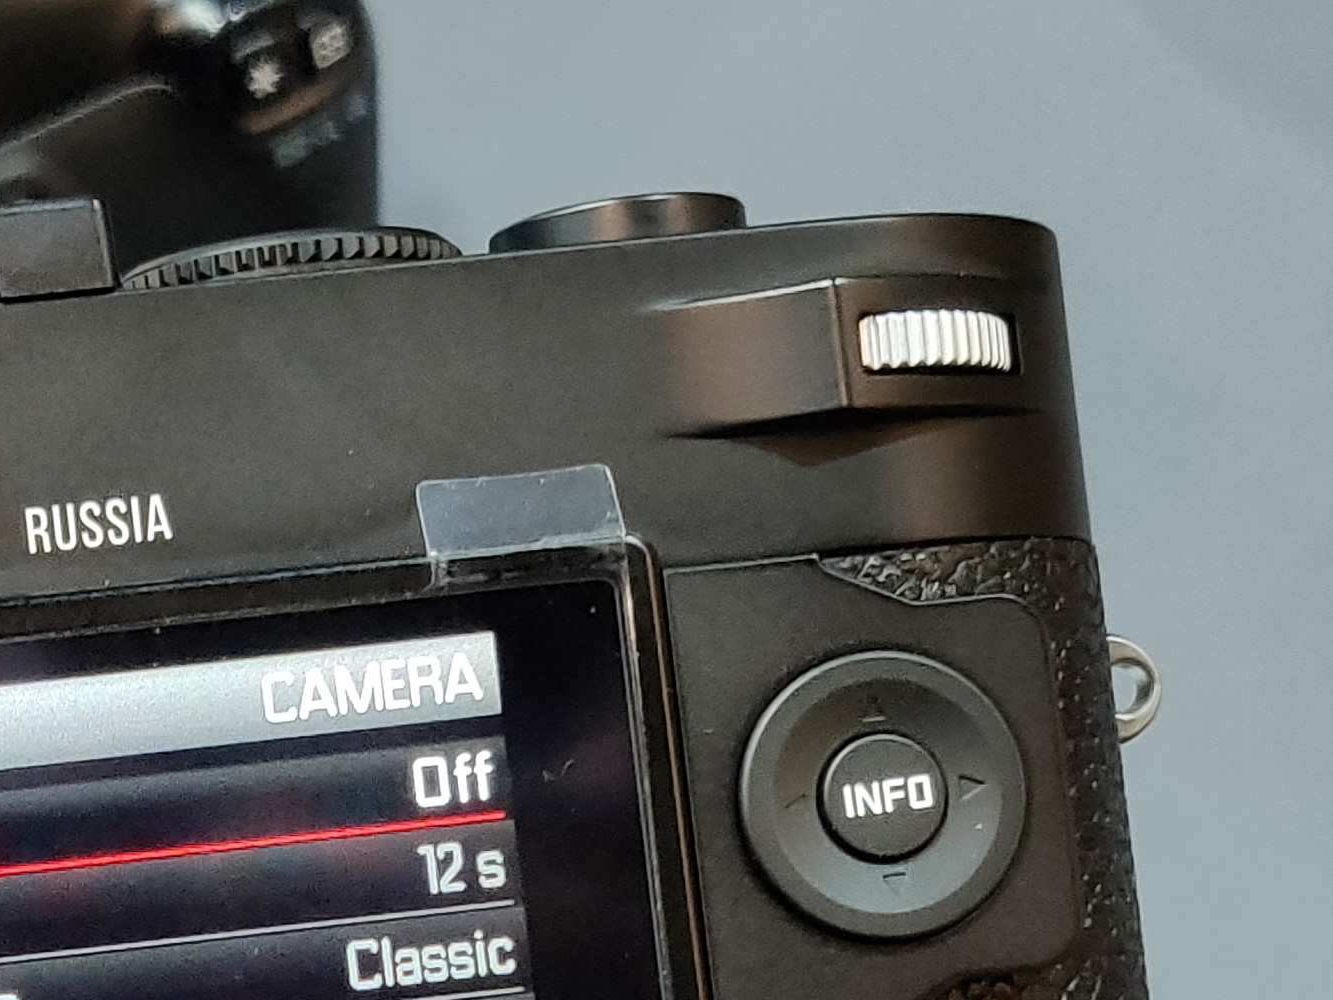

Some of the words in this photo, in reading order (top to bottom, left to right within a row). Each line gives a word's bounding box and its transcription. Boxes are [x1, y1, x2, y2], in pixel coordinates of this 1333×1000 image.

[25, 493, 174, 554] RUSSIA
[261, 654, 483, 725] CAMERA
[412, 752, 496, 809] Off
[843, 774, 934, 818] INFO
[416, 843, 463, 896] 12
[477, 850, 507, 888] s
[346, 932, 517, 991] Classic
